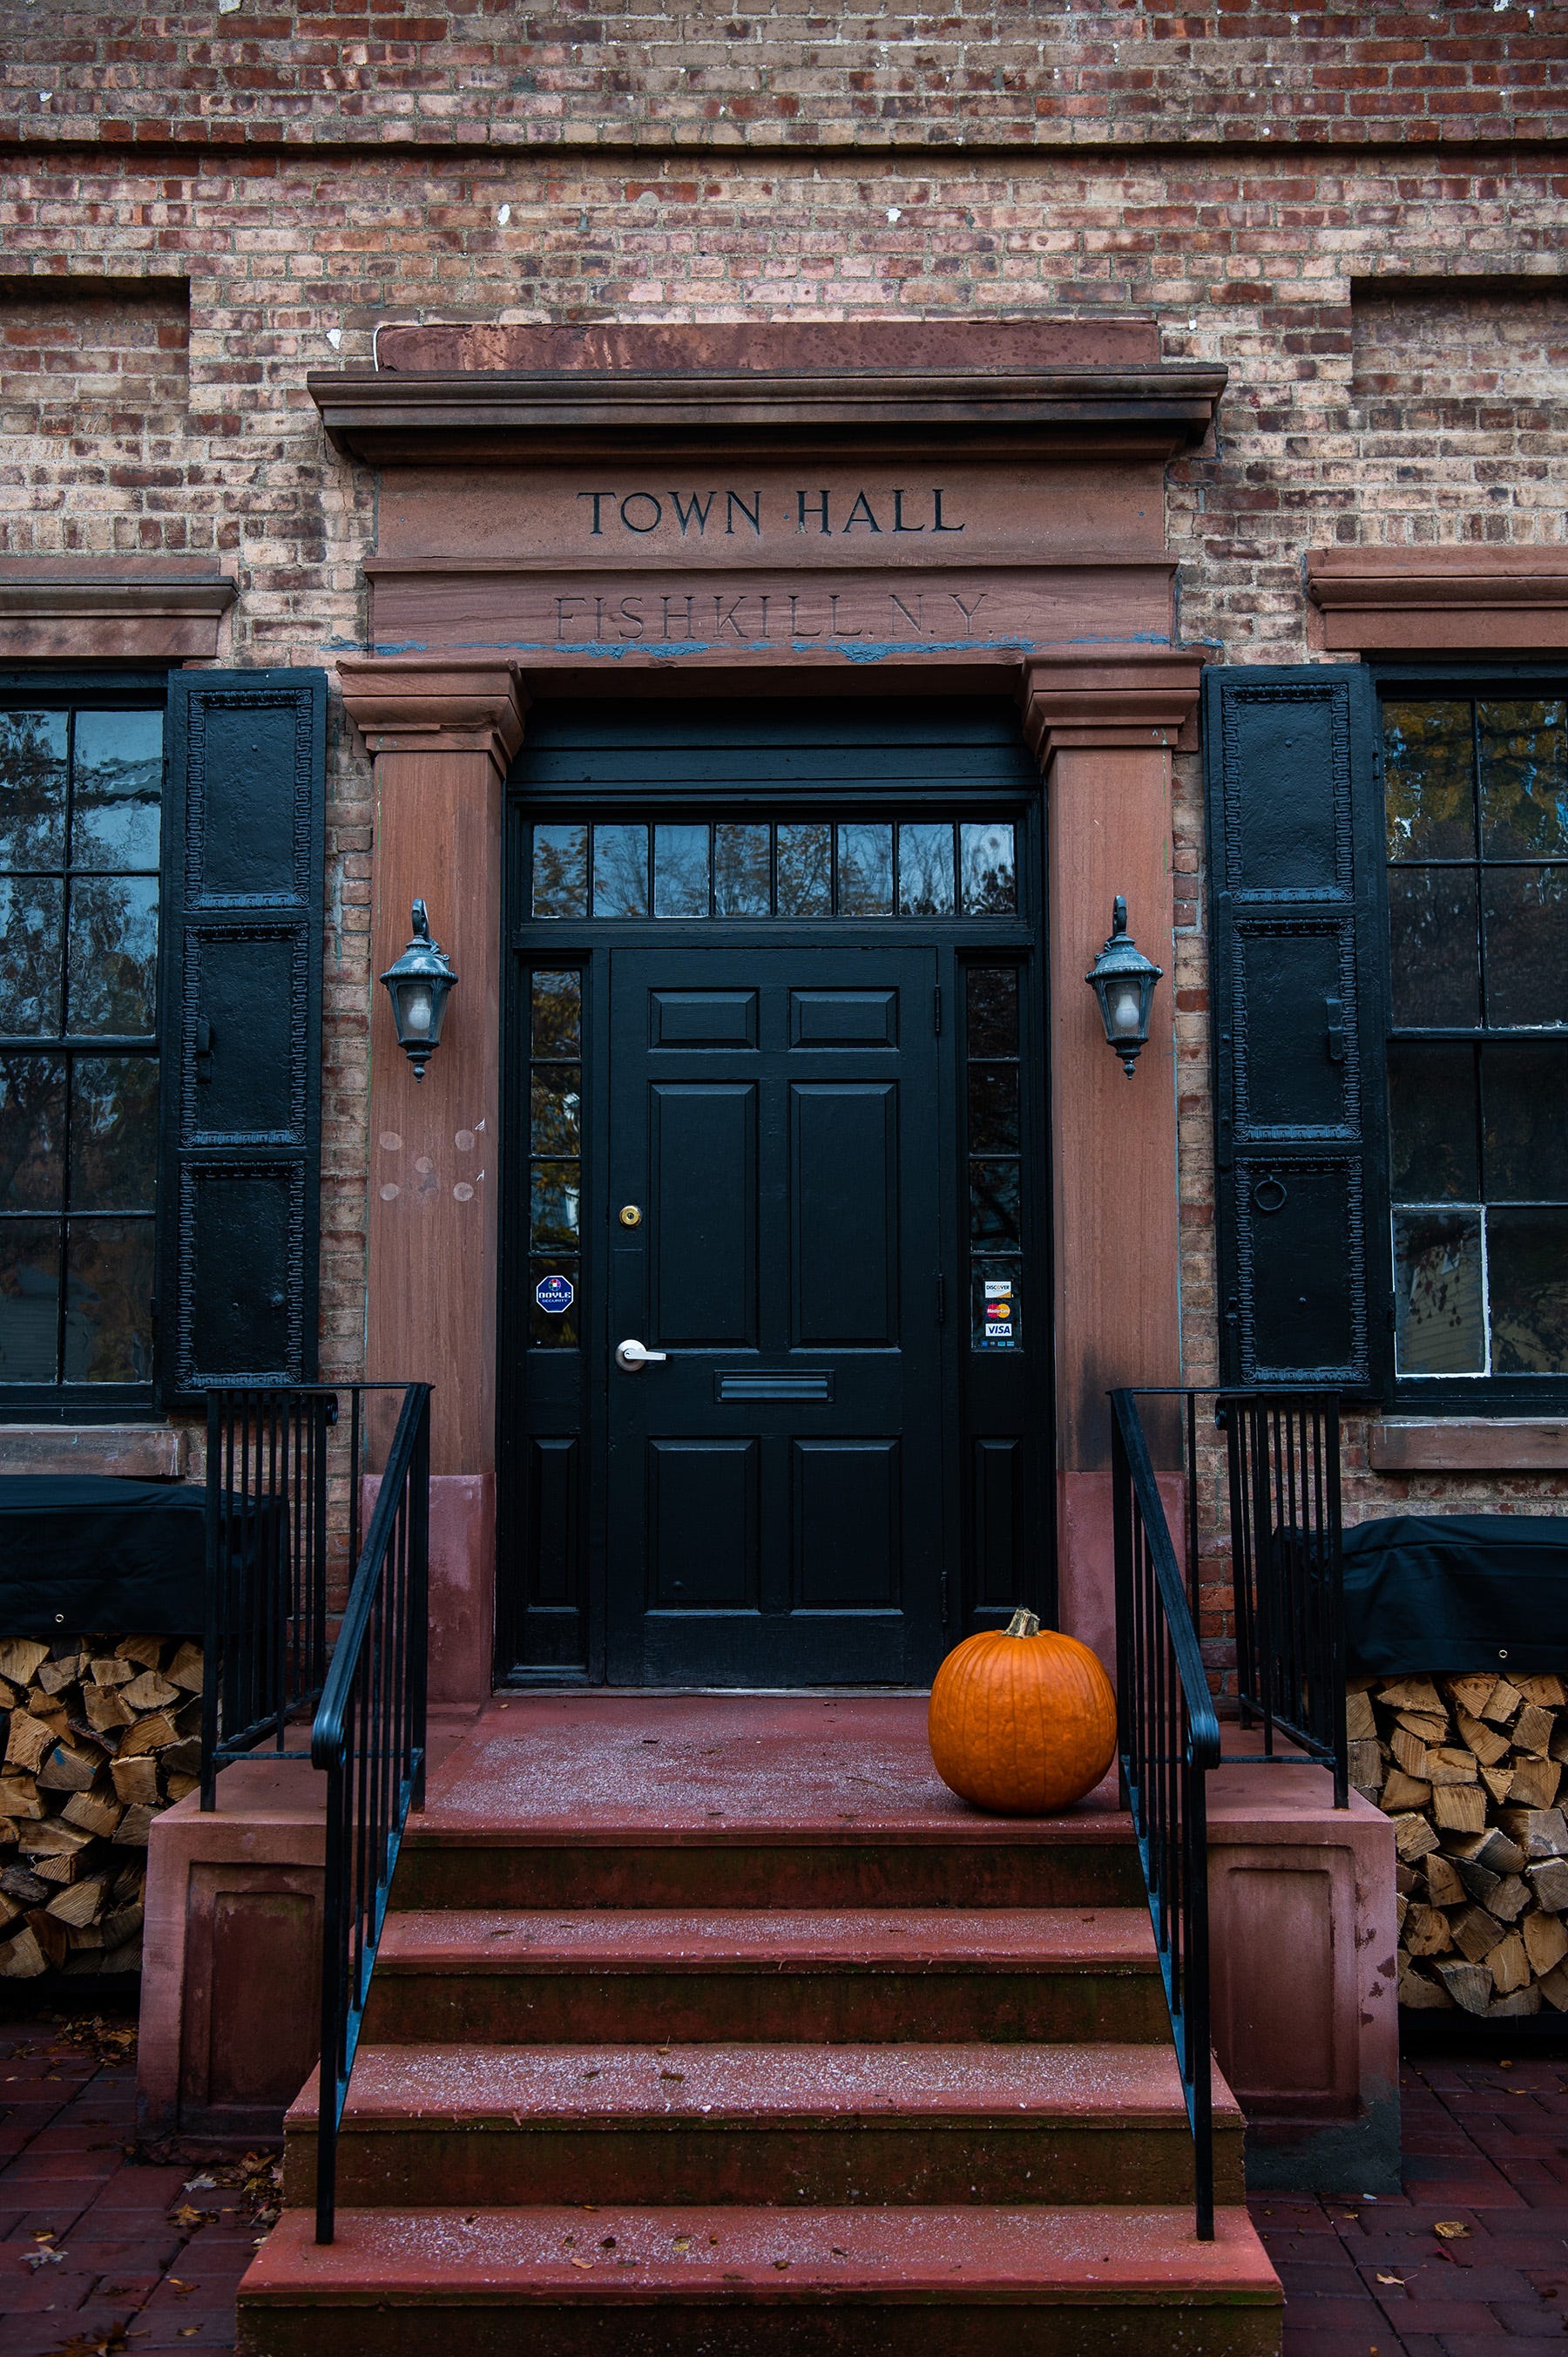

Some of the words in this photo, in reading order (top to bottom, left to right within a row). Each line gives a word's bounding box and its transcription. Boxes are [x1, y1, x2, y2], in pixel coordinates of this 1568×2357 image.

[578, 491, 762, 536] TOWN
[795, 488, 966, 536] HALL
[889, 593, 995, 638] N.Y.
[989, 1325, 1010, 1334] VISA
